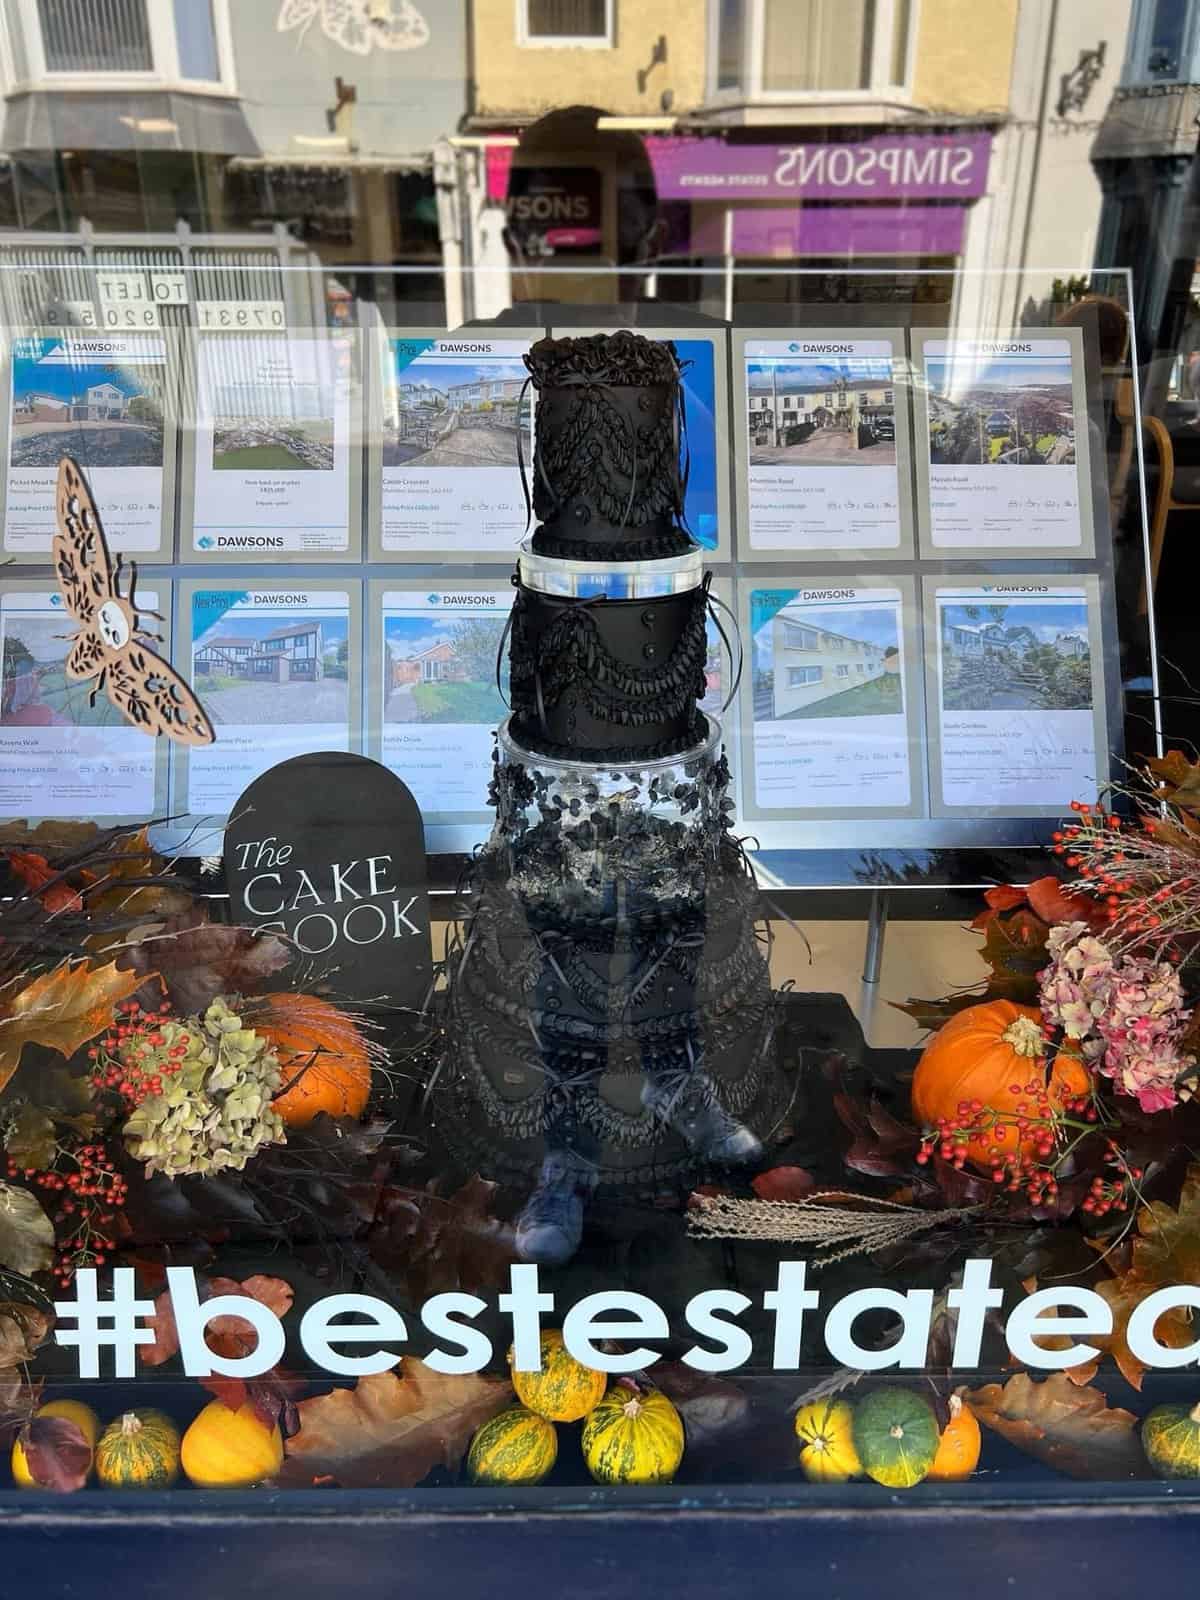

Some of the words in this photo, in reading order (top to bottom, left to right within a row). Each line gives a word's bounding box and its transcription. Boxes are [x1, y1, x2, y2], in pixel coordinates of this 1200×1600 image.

[73, 343, 127, 352] DAWSONS
[440, 344, 492, 353] DAWSONS
[802, 344, 854, 353] DAWSONS
[982, 343, 1032, 352] DAWSONS
[217, 536, 284, 547] DAWSONS
[254, 594, 308, 604] DAWSONS
[803, 589, 855, 600] DAWSONS
[443, 595, 496, 604] DAWSONS
[235, 837, 293, 871] The
[244, 855, 397, 916] CAKE
